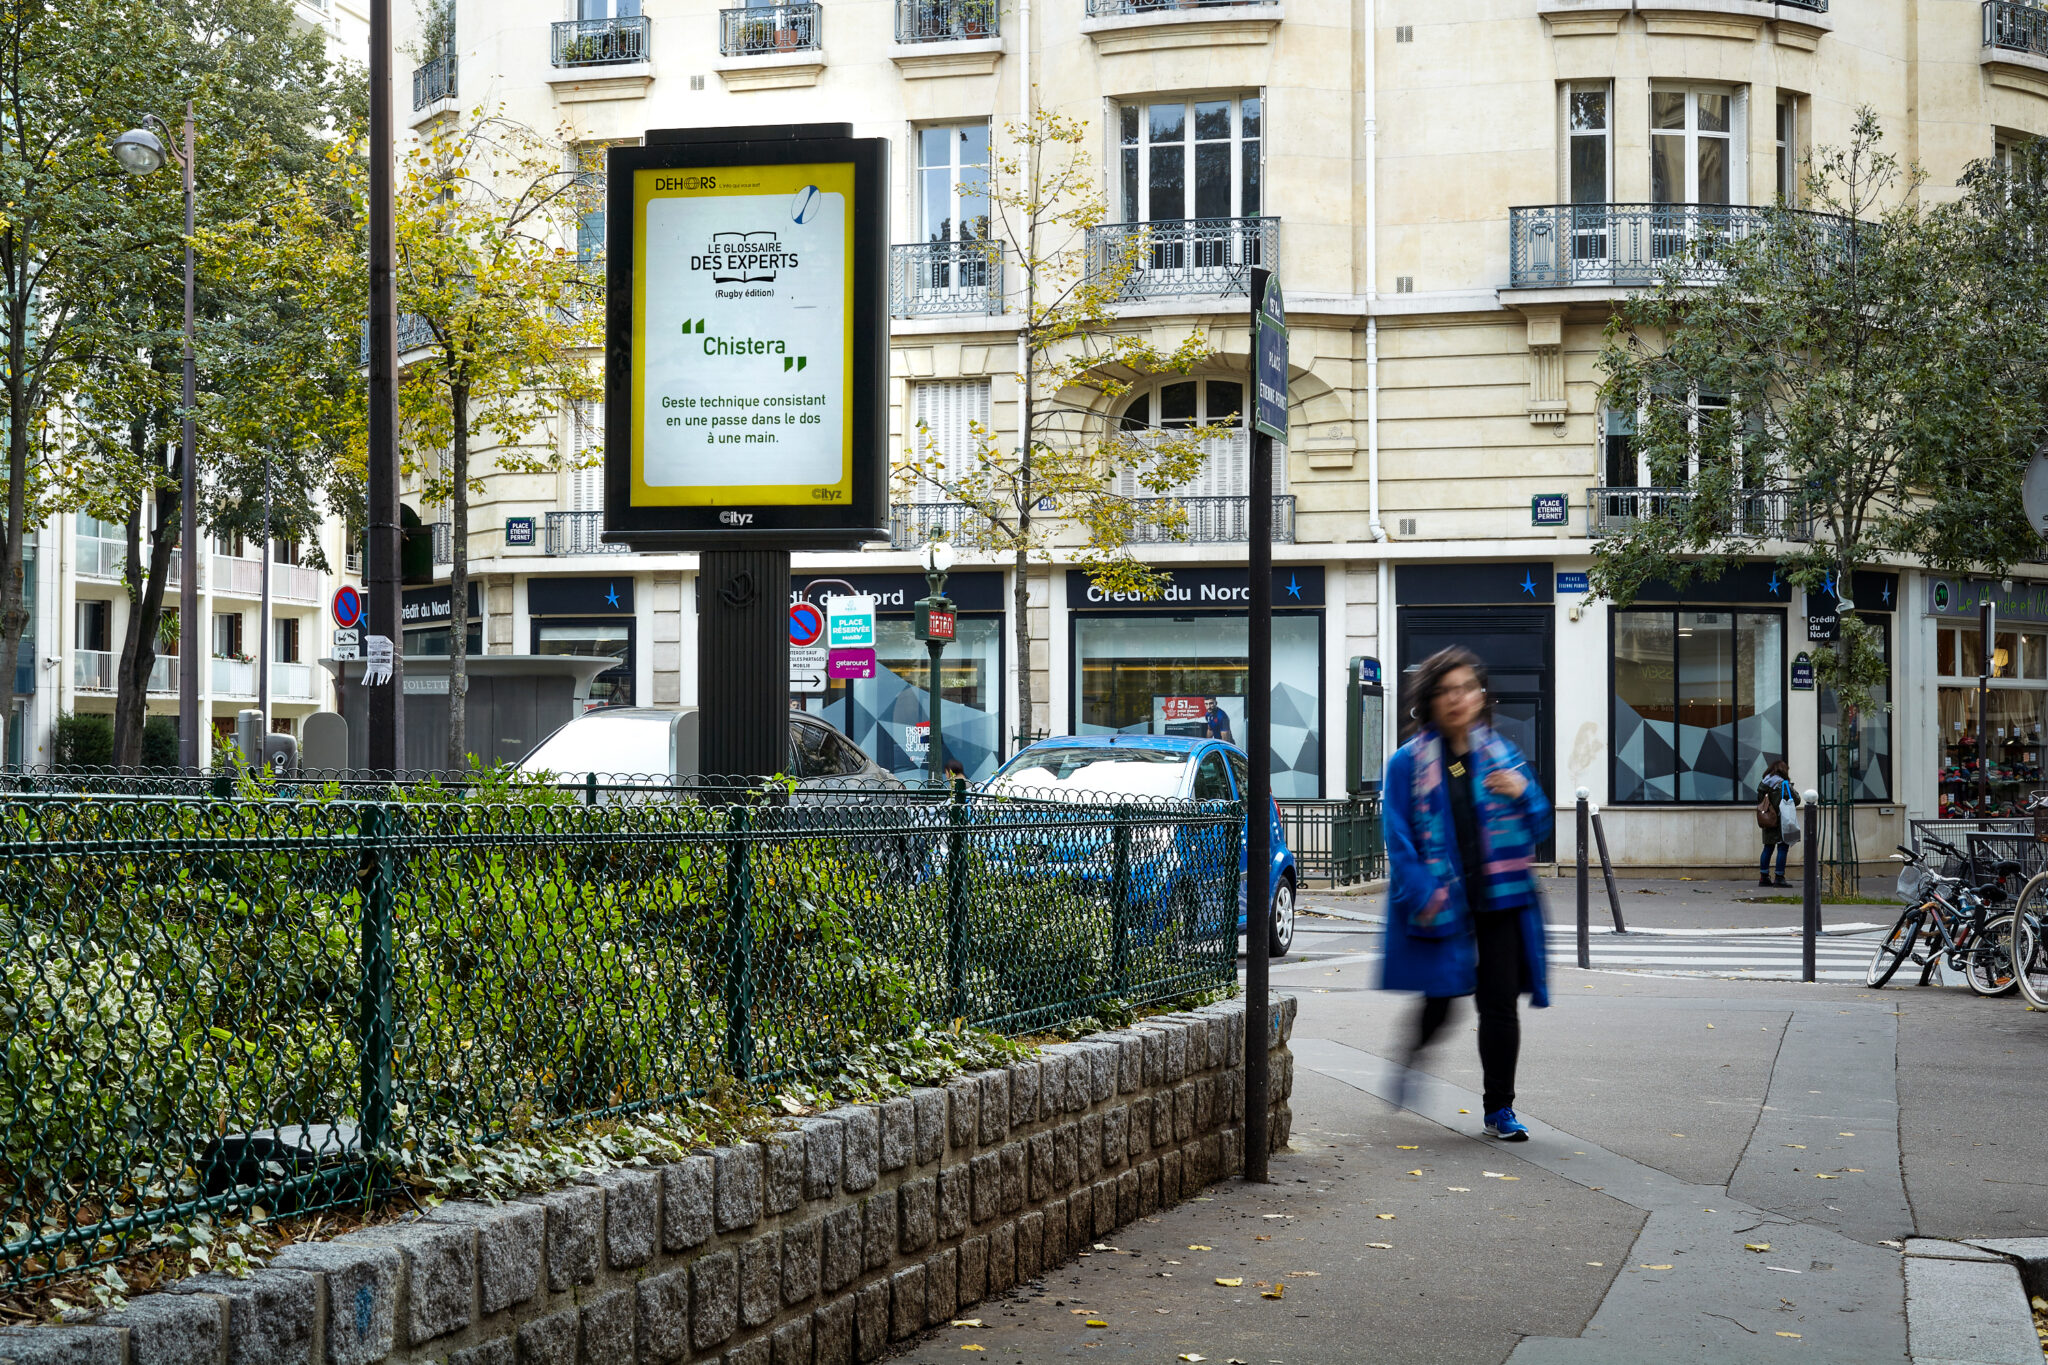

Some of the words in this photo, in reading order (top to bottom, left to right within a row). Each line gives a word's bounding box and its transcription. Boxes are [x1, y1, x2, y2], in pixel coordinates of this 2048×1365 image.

[655, 176, 717, 190] DEHORS
[708, 244, 721, 254] LE
[723, 242, 782, 253] GLOSSAIRE
[691, 255, 722, 271] DES
[727, 253, 799, 270] EXPERTS
[715, 290, 743, 299] (Rugby
[745, 289, 775, 298] édition)
[703, 336, 786, 356] Chistera
[1268, 351, 1281, 372] PLACE
[662, 396, 696, 408] Geste
[700, 395, 759, 410] technique
[763, 394, 826, 407] consistant
[1275, 391, 1287, 411] PERNET
[666, 416, 681, 426] en
[685, 416, 708, 426] une
[711, 415, 747, 428] passe
[751, 413, 781, 425] dans
[784, 412, 795, 425] le
[799, 412, 821, 424] dos
[707, 432, 714, 444] à
[718, 434, 741, 444] une
[745, 431, 779, 444] main.
[811, 488, 842, 500] Cityz
[719, 510, 753, 526] Cityz
[1164, 585, 1192, 602] du
[1958, 582, 1973, 611] Le
[1979, 585, 2017, 615] Mnde
[2020, 597, 2032, 616] et
[402, 603, 419, 619] rédit
[420, 602, 430, 617] du
[431, 600, 451, 616] Nord
[832, 624, 870, 634] RÉSERVÉE
[839, 618, 863, 626] PLACE
[835, 660, 868, 668] getaround
[1177, 700, 1189, 709] 51
